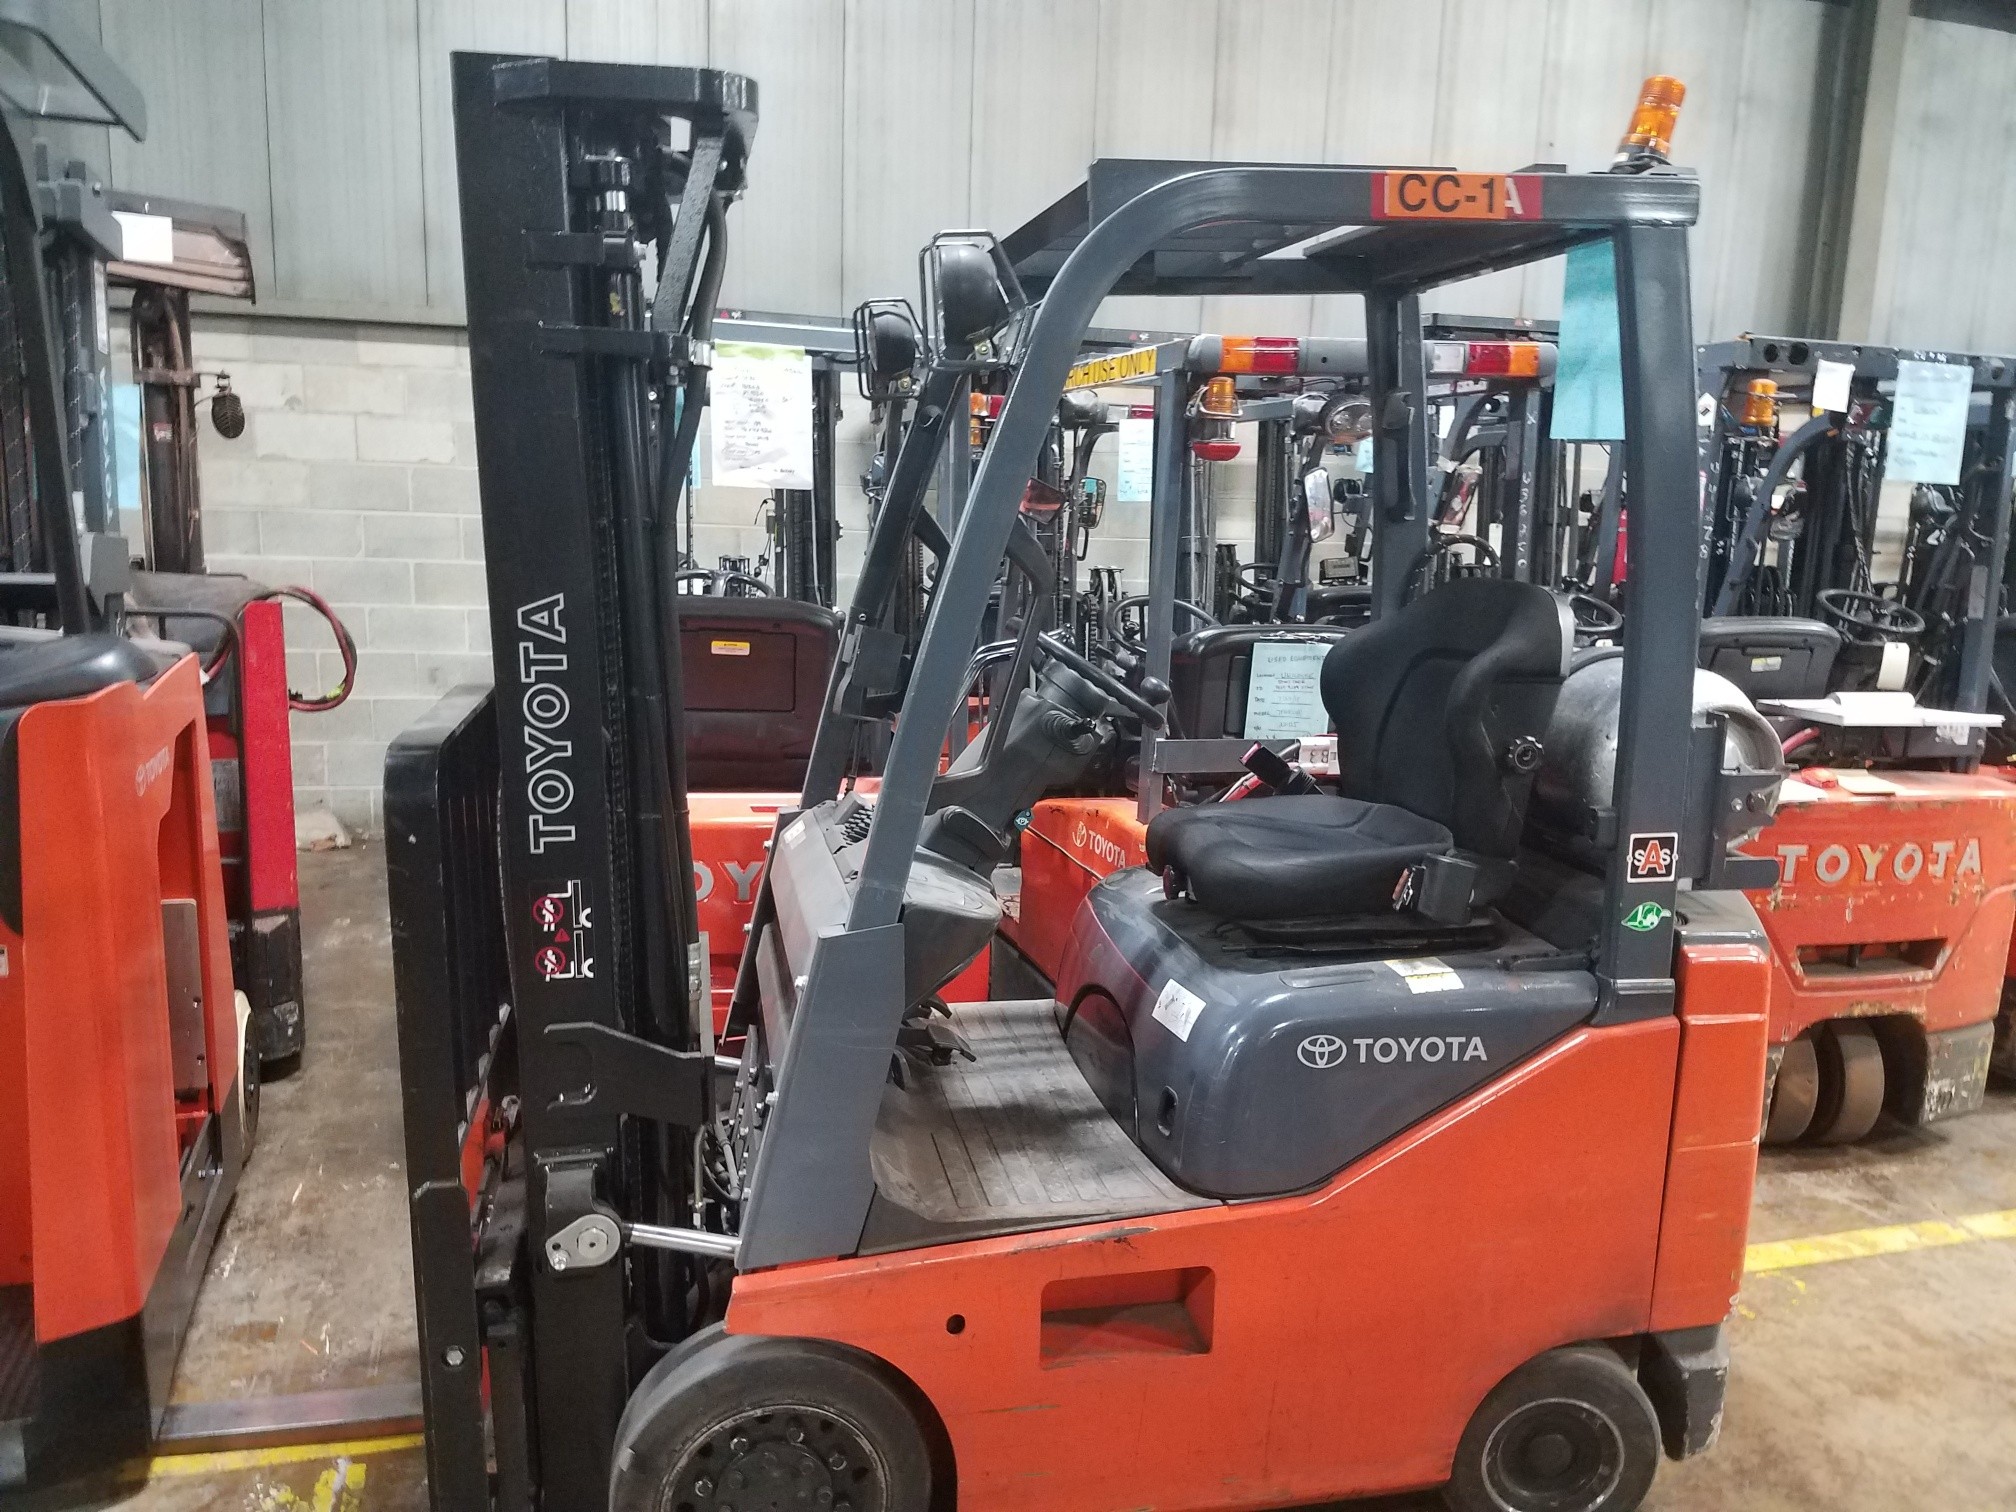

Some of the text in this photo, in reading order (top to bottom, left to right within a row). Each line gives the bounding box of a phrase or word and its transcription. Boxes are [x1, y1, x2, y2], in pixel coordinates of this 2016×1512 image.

[1120, 348, 1156, 379] ONLY
[517, 592, 577, 854] TOYOTA
[1089, 829, 1126, 868] TOYOTA
[1633, 839, 1671, 875] SAS
[1777, 838, 1983, 885] TOYOTA
[1353, 1036, 1488, 1063] TOYOTA
